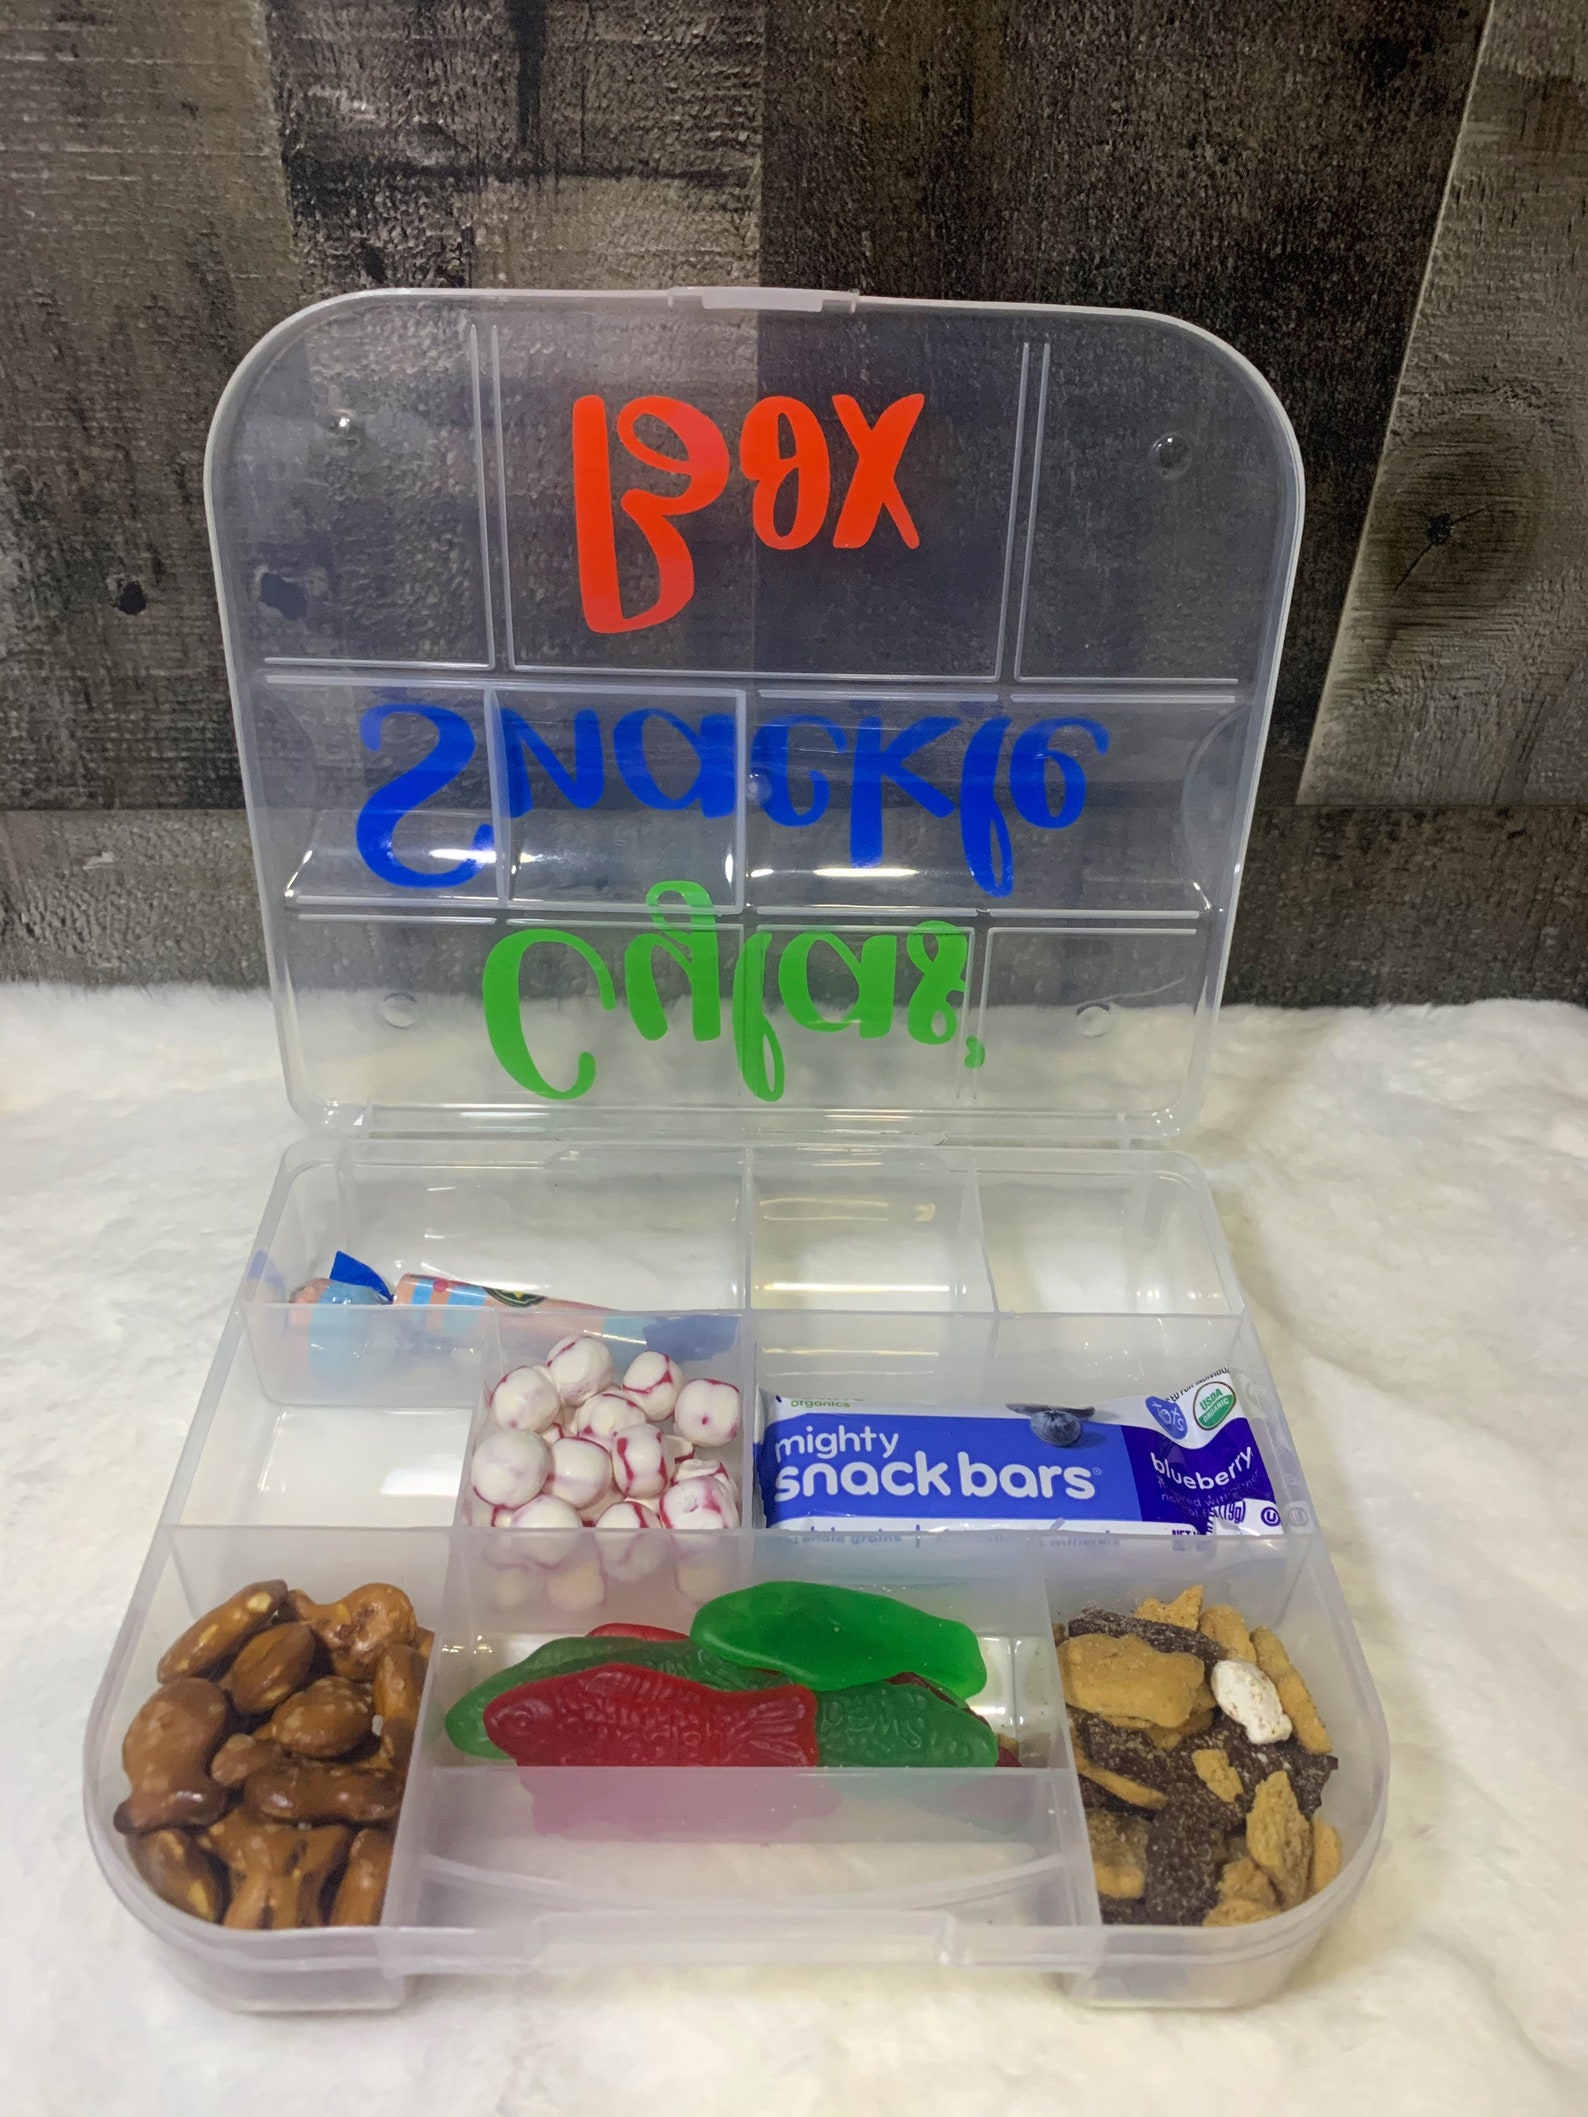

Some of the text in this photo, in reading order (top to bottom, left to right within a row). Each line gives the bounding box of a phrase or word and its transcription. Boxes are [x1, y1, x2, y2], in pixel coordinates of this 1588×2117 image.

[1199, 1388, 1223, 1411] USDA
[1203, 1397, 1230, 1423] ORGANIC
[775, 1425, 899, 1463] mighty
[774, 1450, 1095, 1502] snack bars
[1150, 1446, 1252, 1489] blueberry
